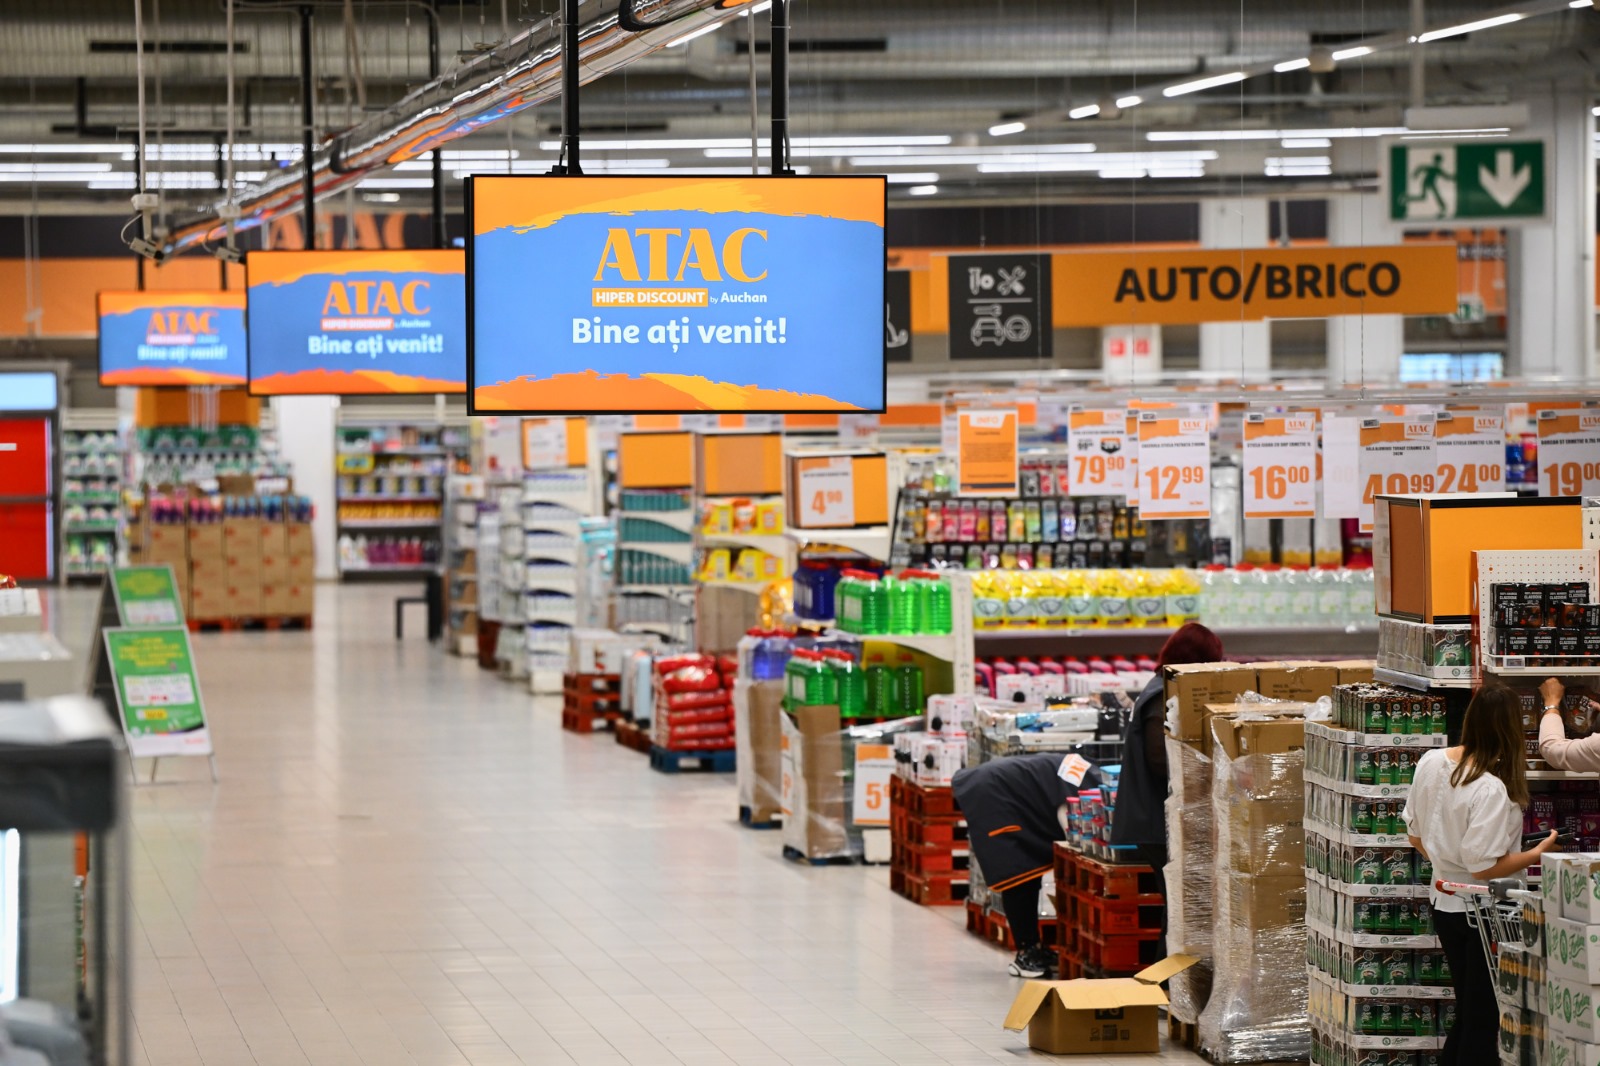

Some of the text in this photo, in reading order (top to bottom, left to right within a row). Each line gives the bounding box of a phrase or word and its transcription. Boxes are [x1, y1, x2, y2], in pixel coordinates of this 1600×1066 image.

[592, 227, 768, 283] ATAC
[321, 280, 431, 316] ATAC
[596, 291, 768, 305] HIPER DISCOUNT by Auchan
[1114, 261, 1401, 305] AUTO/BRICO
[147, 310, 219, 334] ATAC
[572, 316, 787, 353] Bine ați venit!
[308, 335, 353, 355] Bine
[386, 334, 443, 355] venit!
[1407, 424, 1431, 433] ATAC
[1074, 455, 1106, 485] 79
[1145, 465, 1181, 500] 12
[1182, 466, 1204, 484] 99
[1249, 464, 1310, 500] 16 00
[1410, 474, 1435, 493] 99
[1436, 463, 1501, 494] 24 00
[1543, 461, 1583, 497] 19
